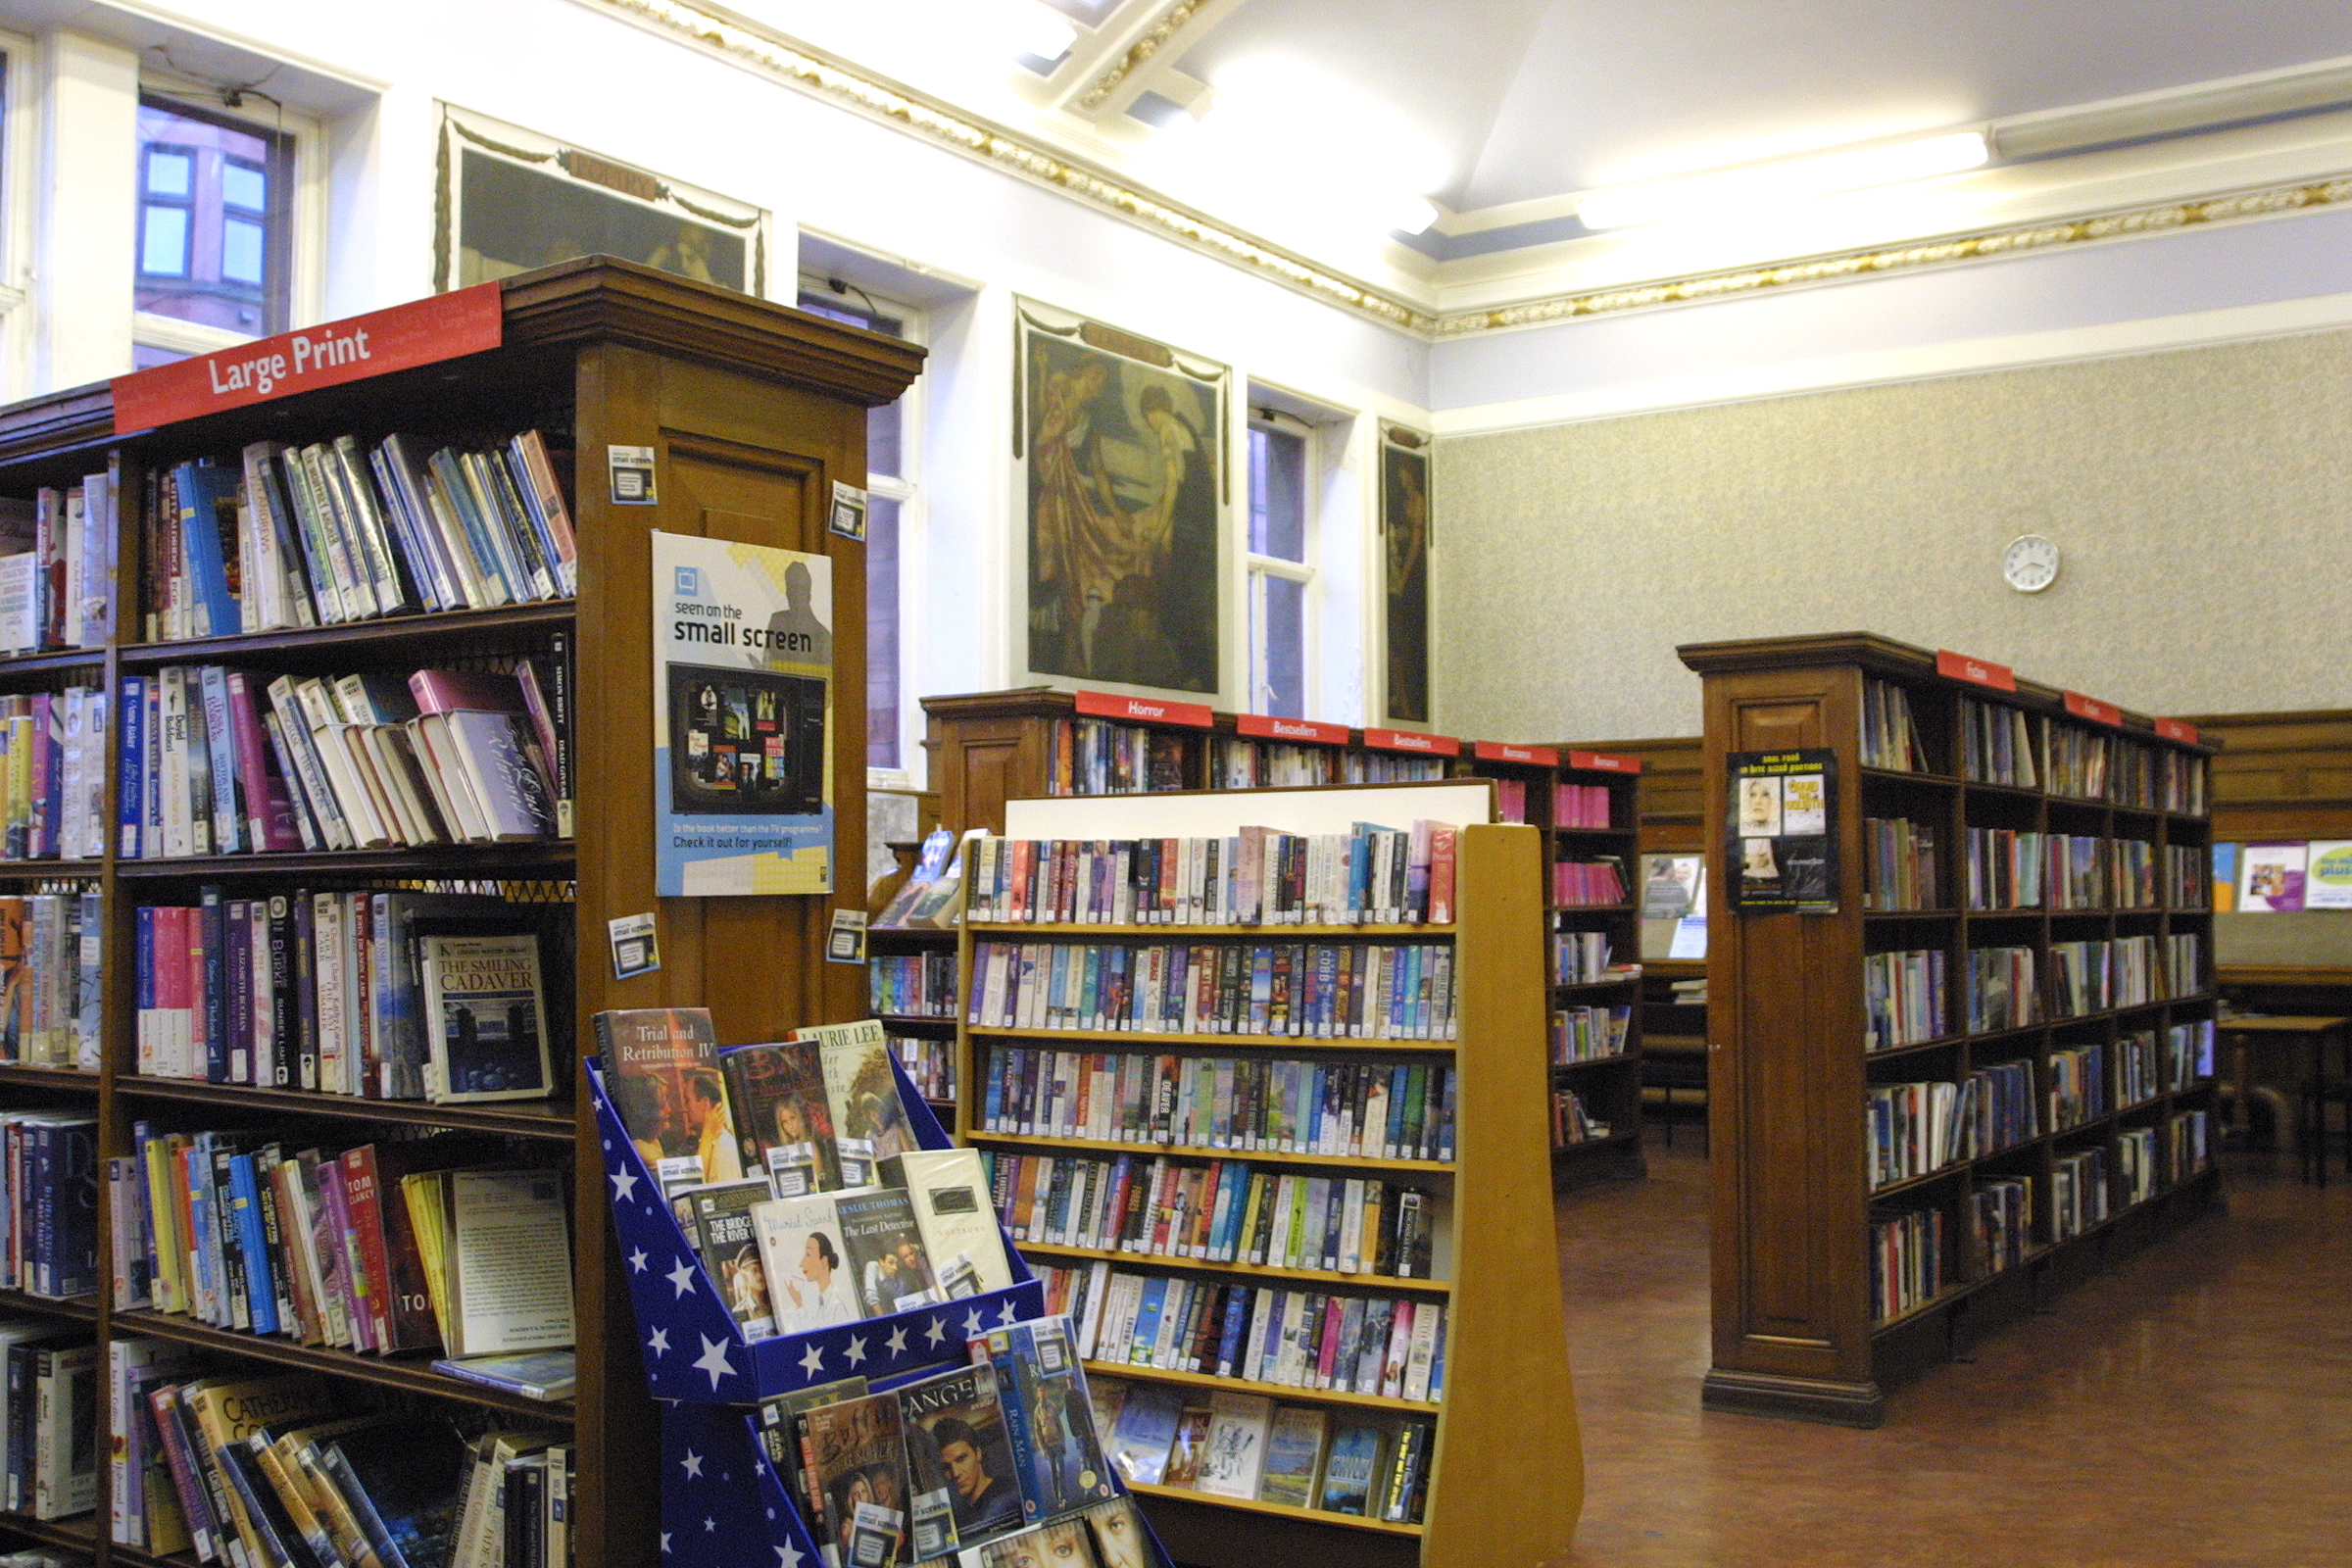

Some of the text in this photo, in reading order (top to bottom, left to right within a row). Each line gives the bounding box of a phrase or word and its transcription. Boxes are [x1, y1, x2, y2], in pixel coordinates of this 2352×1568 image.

[208, 326, 371, 396] Large Print
[675, 602, 742, 619] seen on the
[674, 620, 811, 652] small screen
[1128, 701, 1165, 716] Horror
[166, 715, 175, 753] Baldacci
[175, 714, 187, 741] David
[1273, 720, 1318, 737] Bestsellers
[559, 765, 567, 799] GIVEAW
[673, 836, 704, 849] Check
[708, 836, 714, 848] it
[716, 837, 733, 849] out
[735, 837, 750, 849] for
[271, 939, 286, 989] BURKE
[439, 958, 531, 973] THE SMILING
[1319, 949, 1331, 982] COBB
[237, 947, 248, 1032] ELIZABETH BUCHAN
[440, 971, 534, 991] CADAVER
[275, 998, 285, 1037] SUNSET
[637, 1024, 695, 1043] Trial and
[853, 1025, 879, 1045] LEE
[623, 1043, 713, 1061] Retribution IV
[1159, 1079, 1173, 1114] DEAVER
[348, 1176, 372, 1192] TOM
[349, 1189, 376, 1205] CLANCY
[838, 1196, 910, 1215] LESLIE THOMAS
[710, 1220, 725, 1233] THE
[710, 1228, 749, 1245] THE RIVER
[843, 1225, 860, 1238] The
[861, 1223, 879, 1236] Last
[401, 1293, 433, 1313] TO
[907, 1375, 988, 1418] ANGEL
[1007, 1407, 1027, 1469] RAIN MAN
